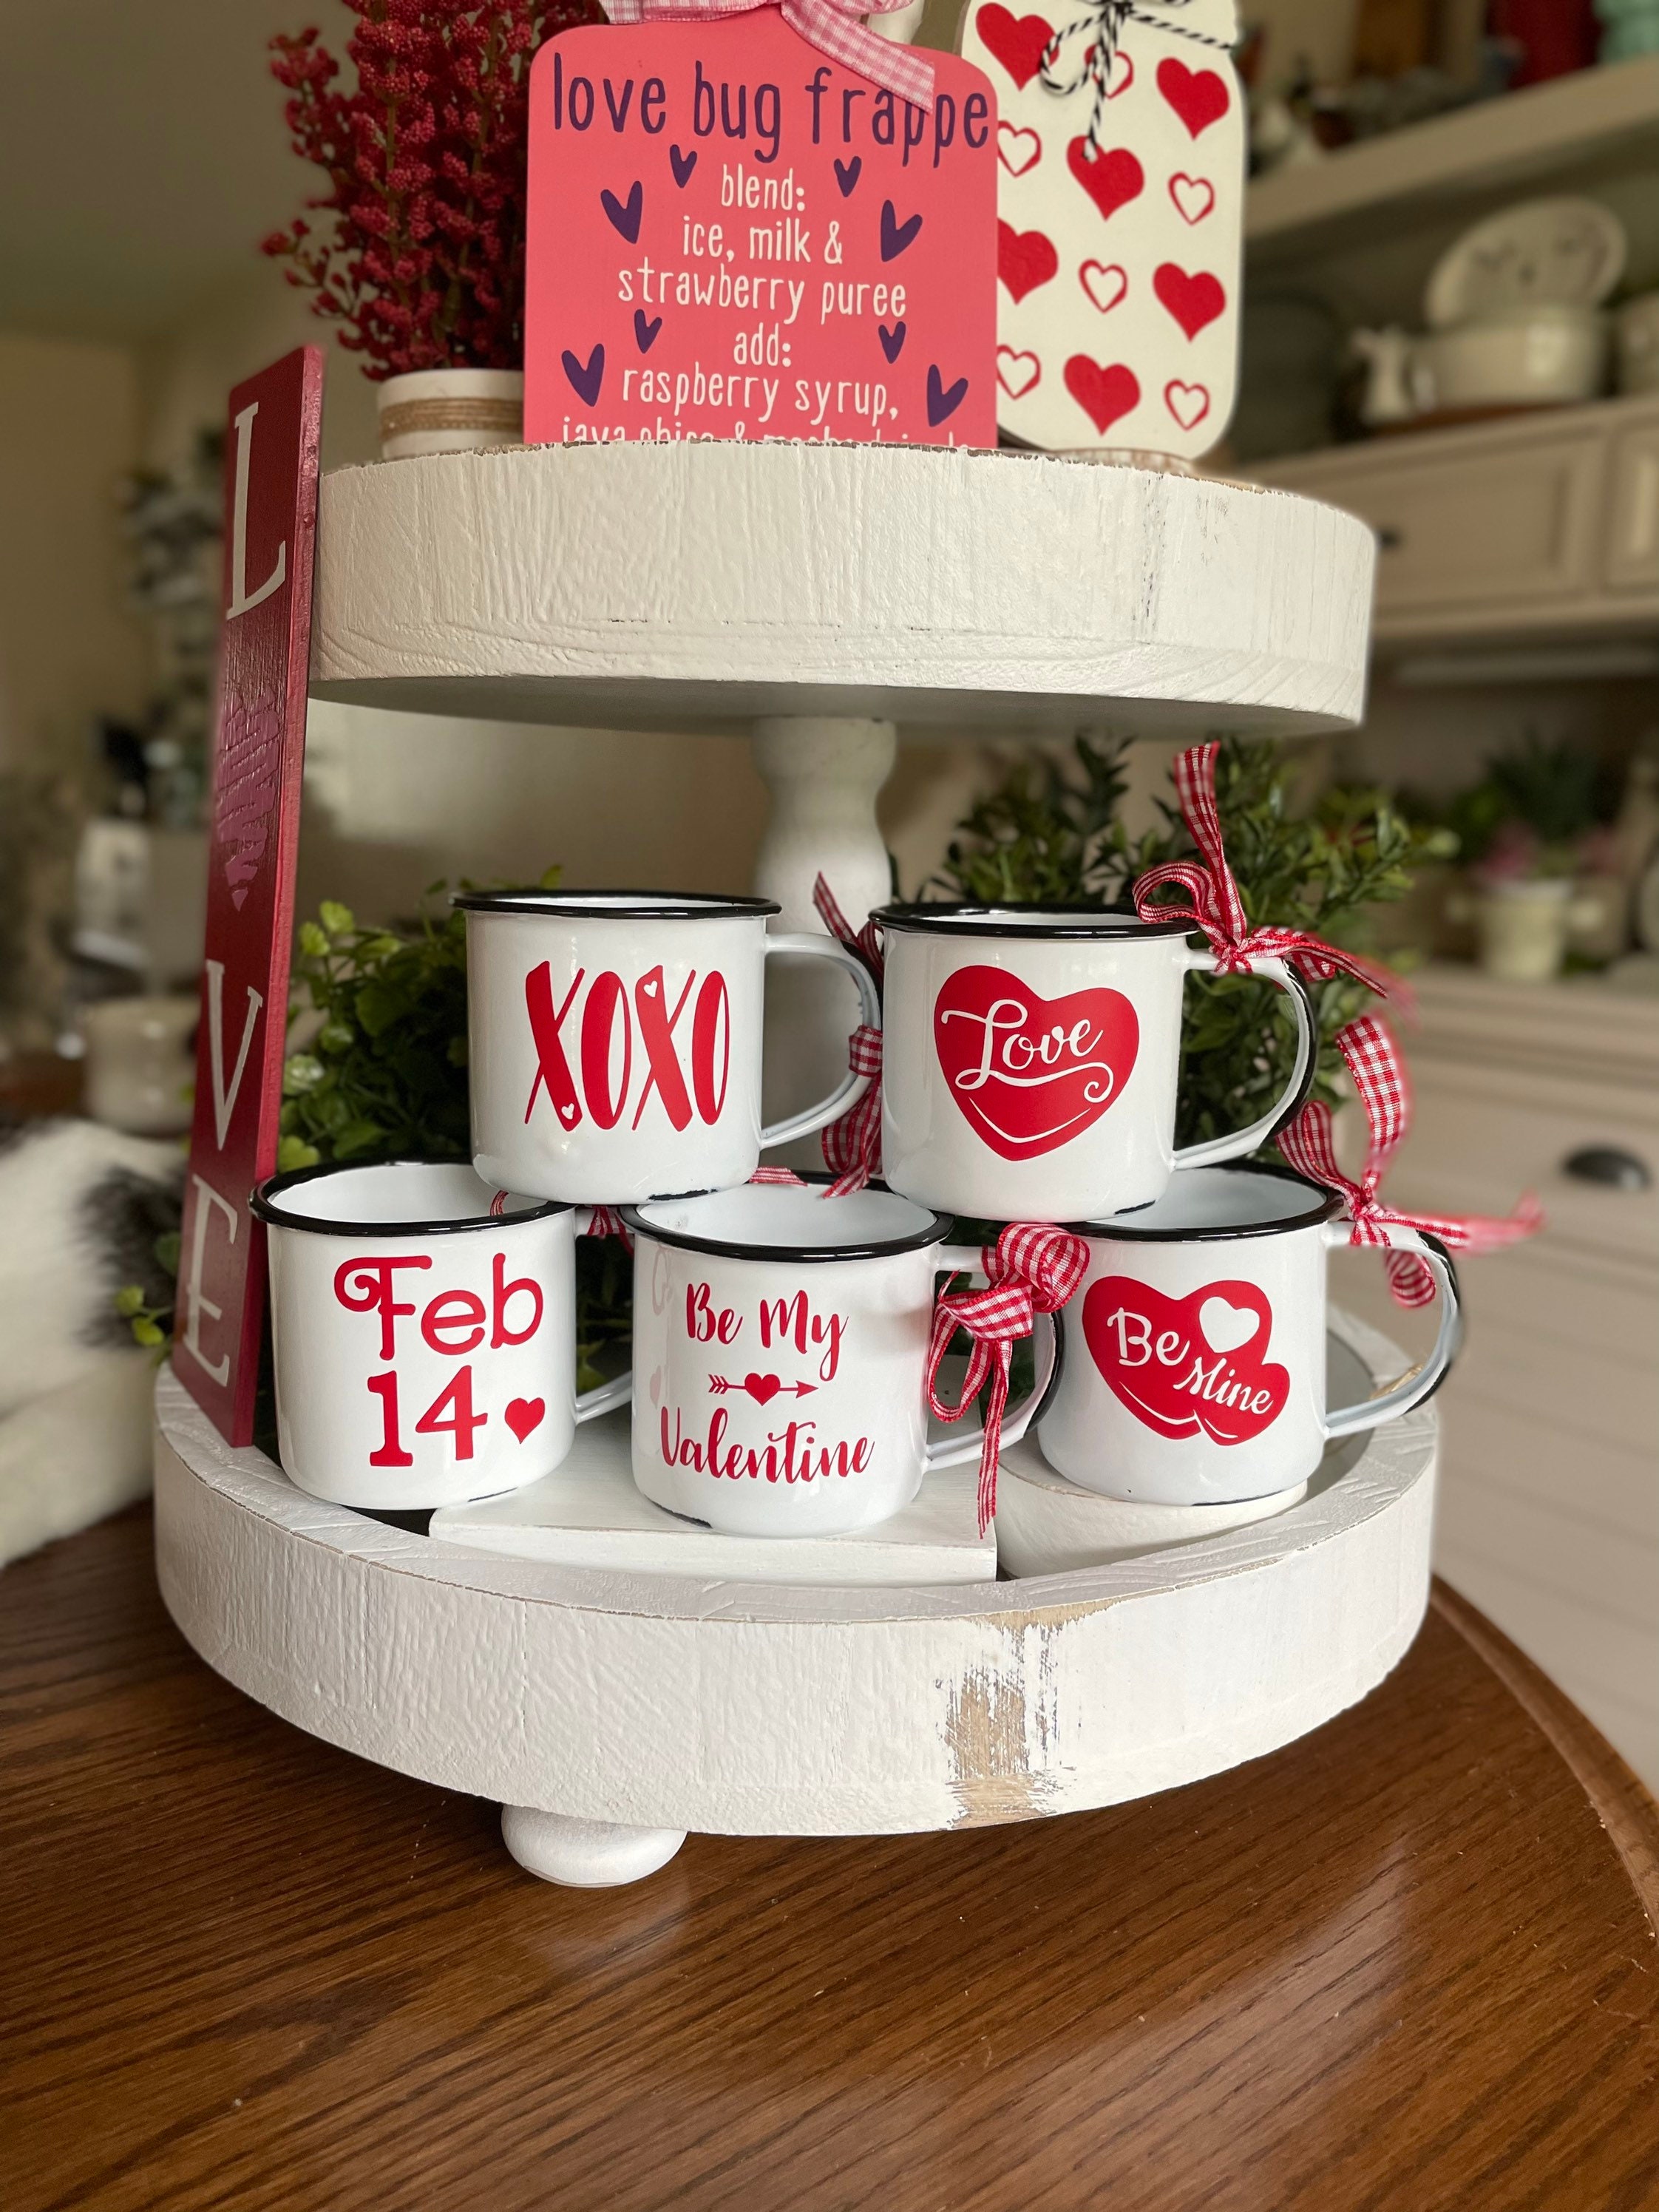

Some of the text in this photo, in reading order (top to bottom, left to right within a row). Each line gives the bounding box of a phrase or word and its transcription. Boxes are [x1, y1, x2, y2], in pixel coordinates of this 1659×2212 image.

[554, 52, 988, 168] love bug frappe
[721, 163, 805, 211] blend:
[683, 215, 843, 265] ice, milk &
[618, 257, 906, 325] strawberry puree
[733, 322, 791, 367] add:
[622, 362, 898, 427] raspberry syrup,
[525, 960, 730, 1133] XOXO
[941, 999, 1114, 1103] Love
[334, 1252, 543, 1360] Feb
[686, 1283, 849, 1381] Be My
[1107, 1307, 1190, 1367] Be
[367, 1365, 488, 1467] 14
[1173, 1357, 1273, 1414] Mine
[660, 1406, 875, 1484] Valentine
